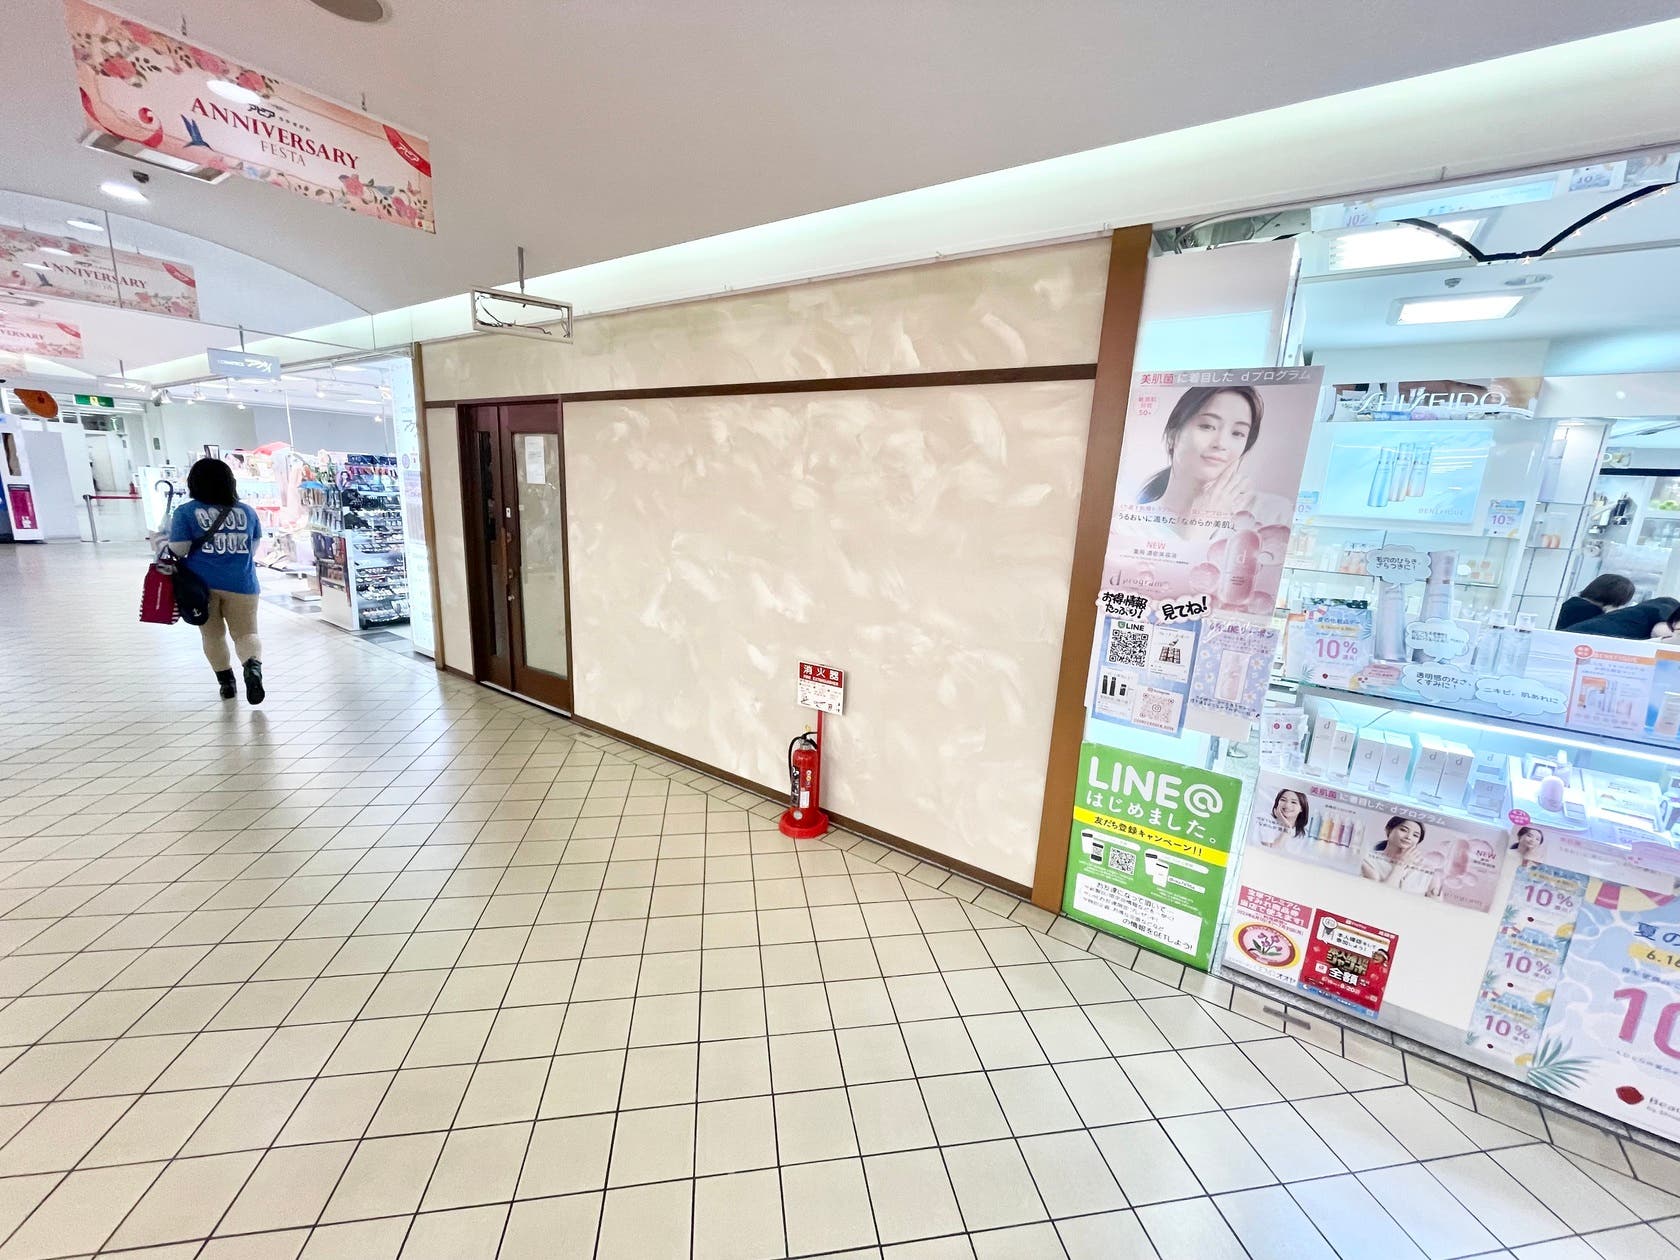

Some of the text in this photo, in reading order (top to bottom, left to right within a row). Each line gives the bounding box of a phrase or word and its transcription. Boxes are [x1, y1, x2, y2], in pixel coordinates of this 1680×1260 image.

[191, 98, 359, 170] ANNIVERSARY
[260, 140, 306, 167] FESTA
[1140, 369, 1312, 385] 美肌菌 に着目した dプログラム
[195, 506, 248, 531] GOOD
[202, 532, 249, 554] LOOK
[1146, 541, 1166, 550] NEW
[1102, 592, 1149, 611] お得情報
[1105, 603, 1144, 619] たっぷり!
[1162, 596, 1208, 621] 見てね!
[1126, 621, 1145, 632] LINE
[803, 664, 839, 681] 消火器
[1088, 756, 1223, 818] LINE@
[1086, 790, 1216, 844] はじめました。
[1094, 816, 1202, 856] 友だち登録キャンペーン!!
[1476, 849, 1496, 860] NEW
[1634, 921, 1680, 946] 夏の
[1329, 967, 1359, 986] 全額
